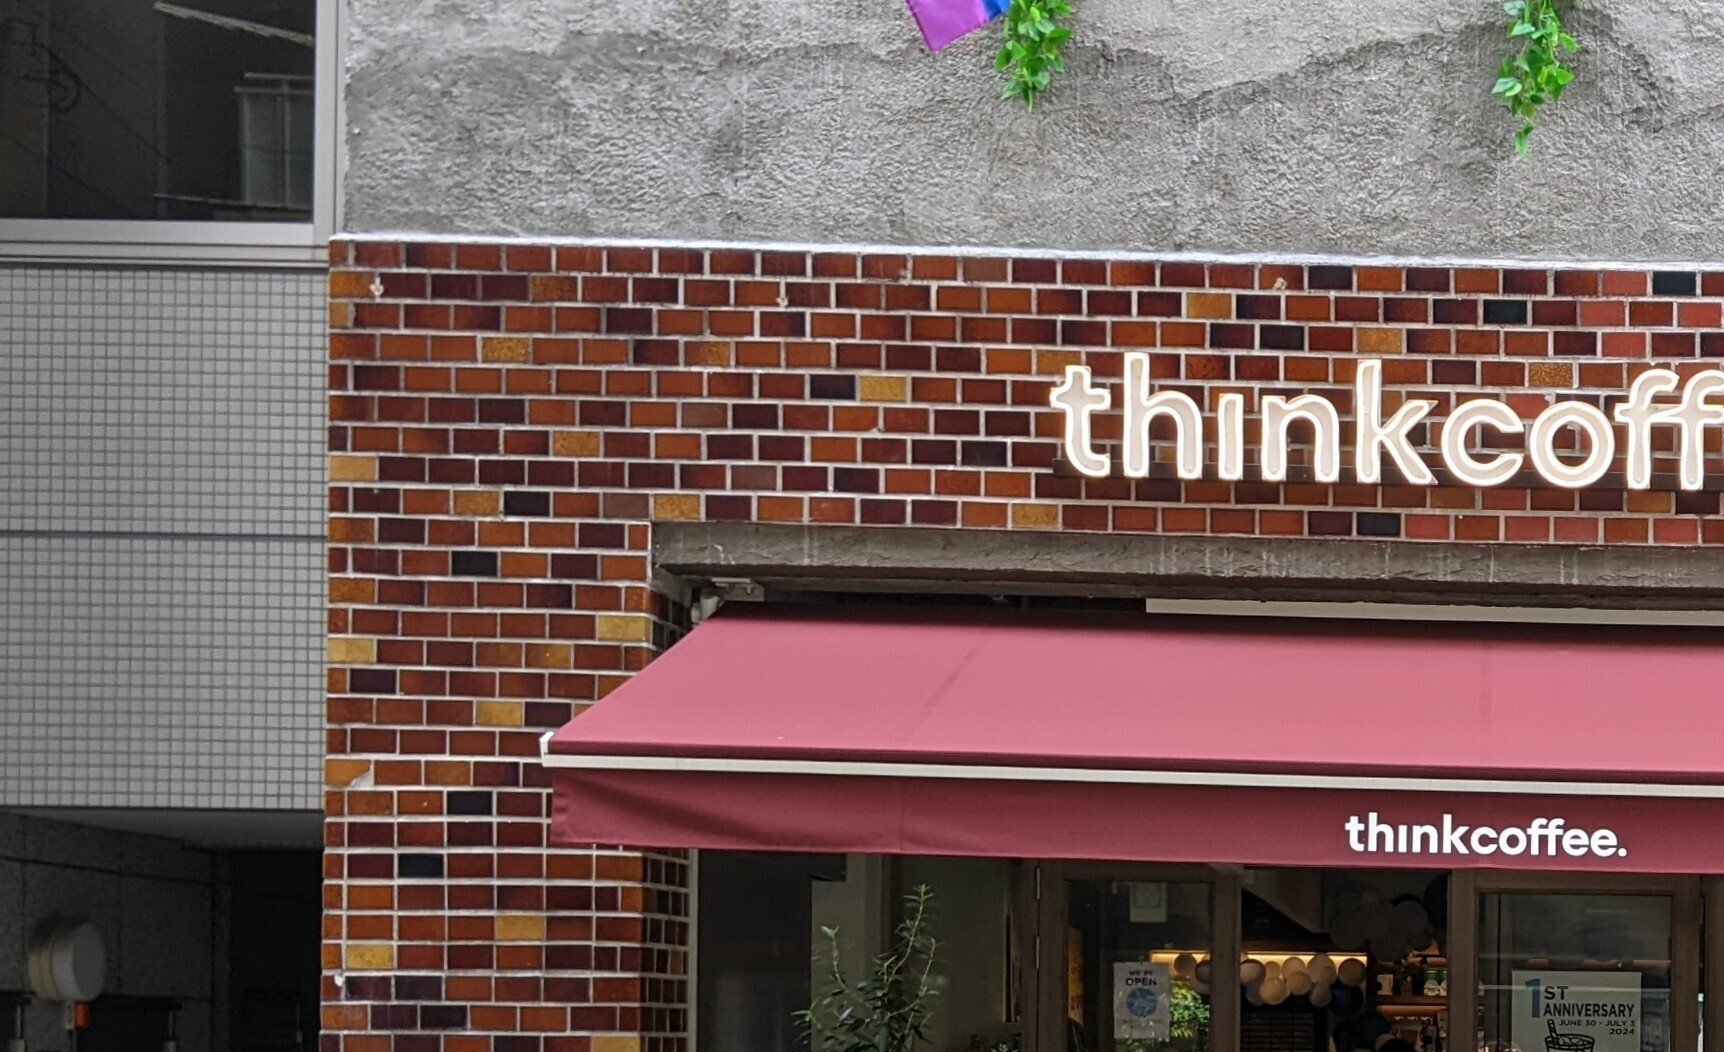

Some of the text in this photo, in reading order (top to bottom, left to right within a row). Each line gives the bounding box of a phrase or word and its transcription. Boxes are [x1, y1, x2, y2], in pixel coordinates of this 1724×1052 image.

[1345, 812, 1627, 857] thinkcoffee.
[1126, 977, 1157, 986] OPEN
[1543, 1002, 1635, 1017] ANNIVERSARY
